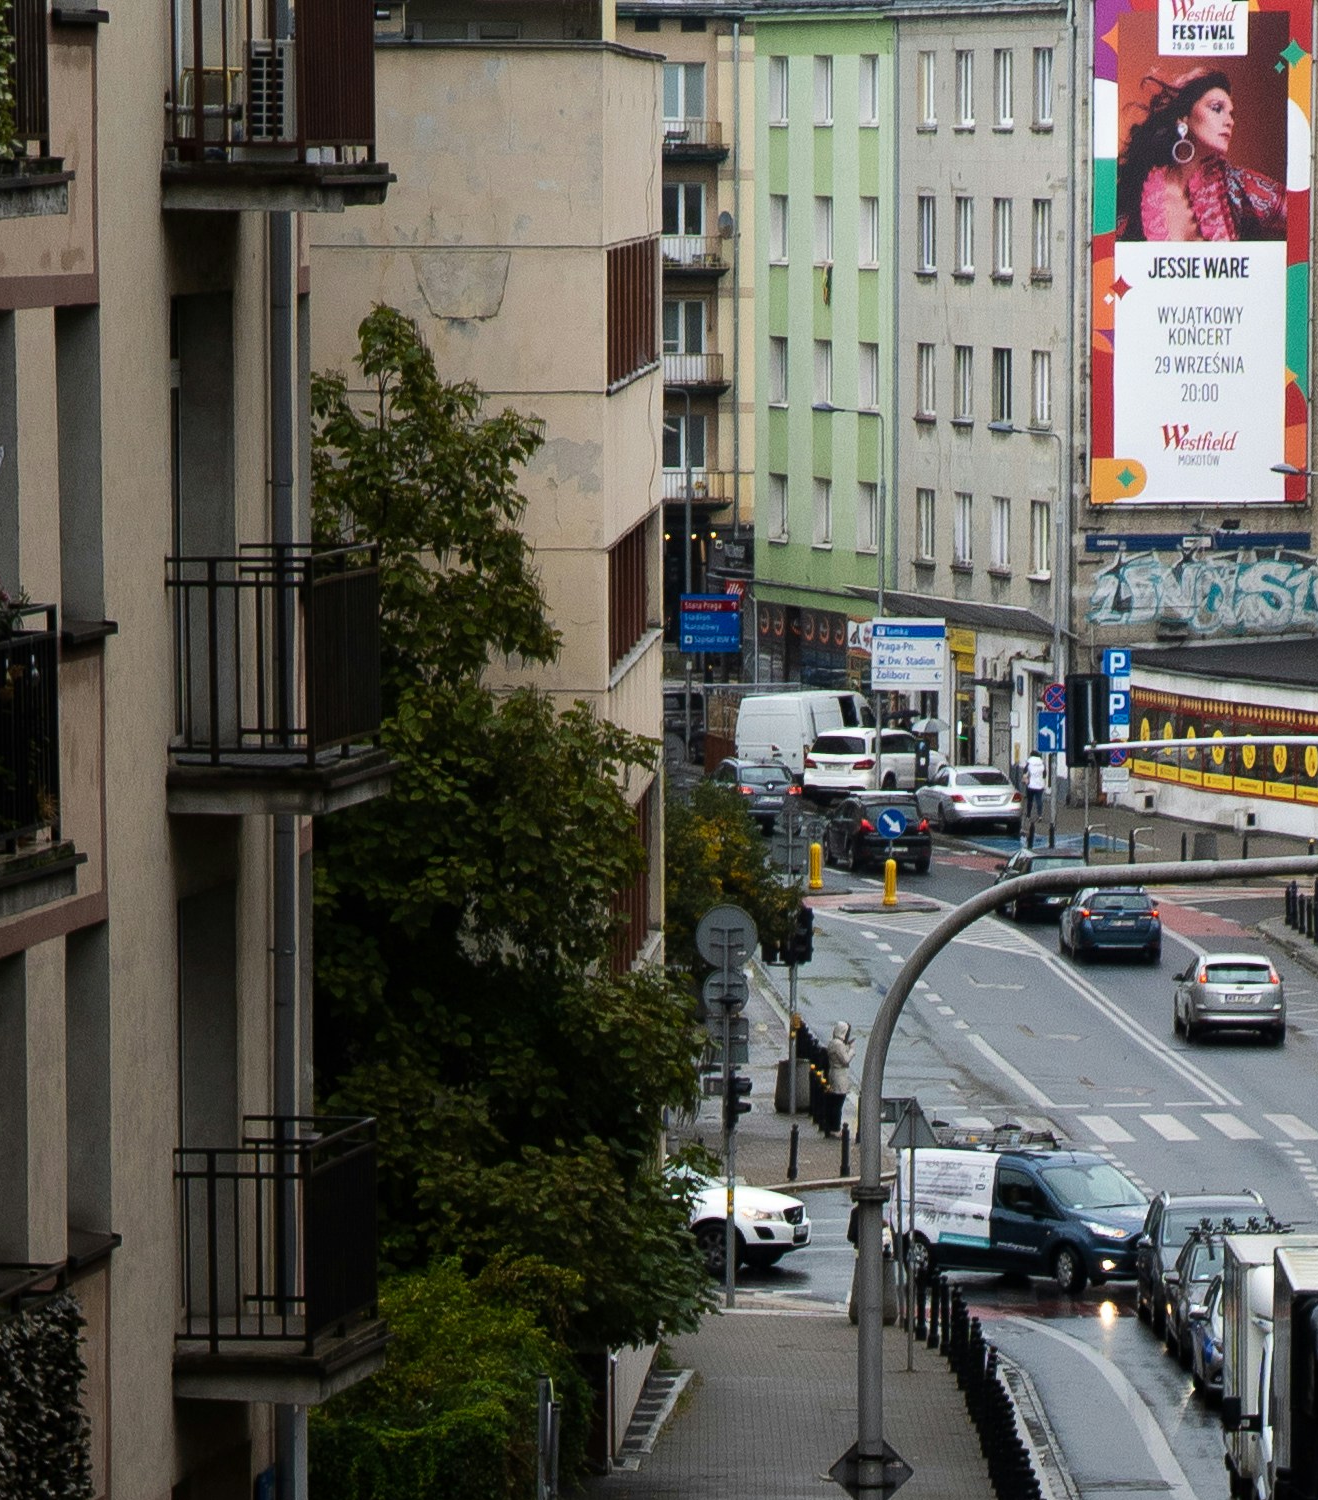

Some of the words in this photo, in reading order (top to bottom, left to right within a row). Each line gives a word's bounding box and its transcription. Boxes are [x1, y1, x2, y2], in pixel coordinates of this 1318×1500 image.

[1171, 0, 1236, 22] Westfield
[1172, 42, 1195, 51] 29.09
[1213, 42, 1235, 51] 08.10
[1148, 257, 1199, 279] JESSIE
[1204, 257, 1250, 279] WARE
[1157, 306, 1244, 329] WYJĄTKOWY
[1168, 327, 1233, 346] KONCERT
[1154, 356, 1171, 375] 29
[1174, 351, 1245, 375] WRZEŚNIA
[1181, 383, 1219, 402] 20:00
[1161, 423, 1239, 451] Westfield
[1177, 453, 1220, 466] MOKOTÓW
[1110, 652, 1126, 673] P
[1109, 695, 1125, 715] P
